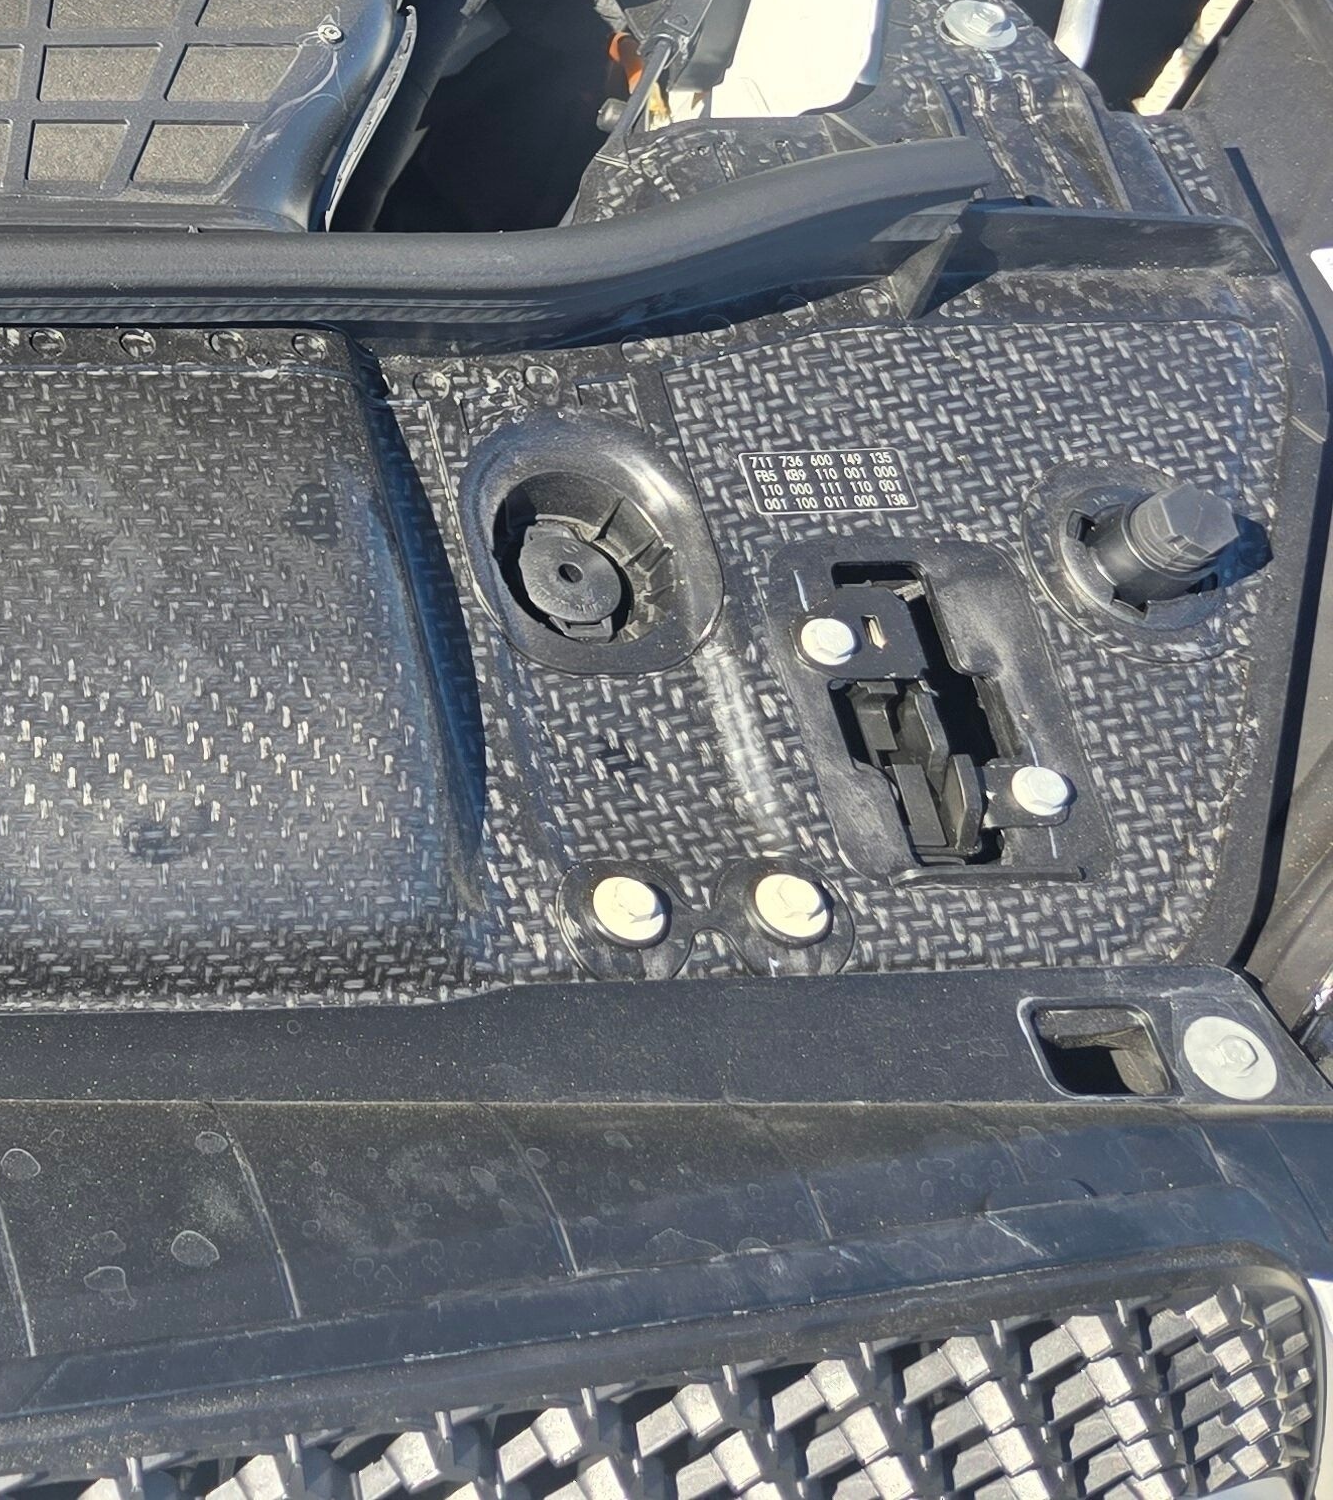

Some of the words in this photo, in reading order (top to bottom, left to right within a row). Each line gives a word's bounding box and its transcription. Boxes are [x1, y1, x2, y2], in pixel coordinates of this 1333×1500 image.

[749, 456, 773, 469] 711
[779, 455, 804, 468] 736
[810, 454, 833, 467] 600
[840, 453, 862, 465] 149
[869, 452, 892, 464] 135
[815, 468, 838, 480] 110
[844, 466, 868, 479] 001
[873, 465, 897, 478] 000
[761, 484, 783, 497] 110
[789, 482, 814, 495] 000
[820, 482, 842, 494] 111
[850, 481, 873, 493] 110
[878, 479, 902, 492] 001
[764, 498, 788, 511] 001
[796, 497, 819, 509] 100
[823, 496, 847, 508] 011
[854, 494, 878, 507] 000
